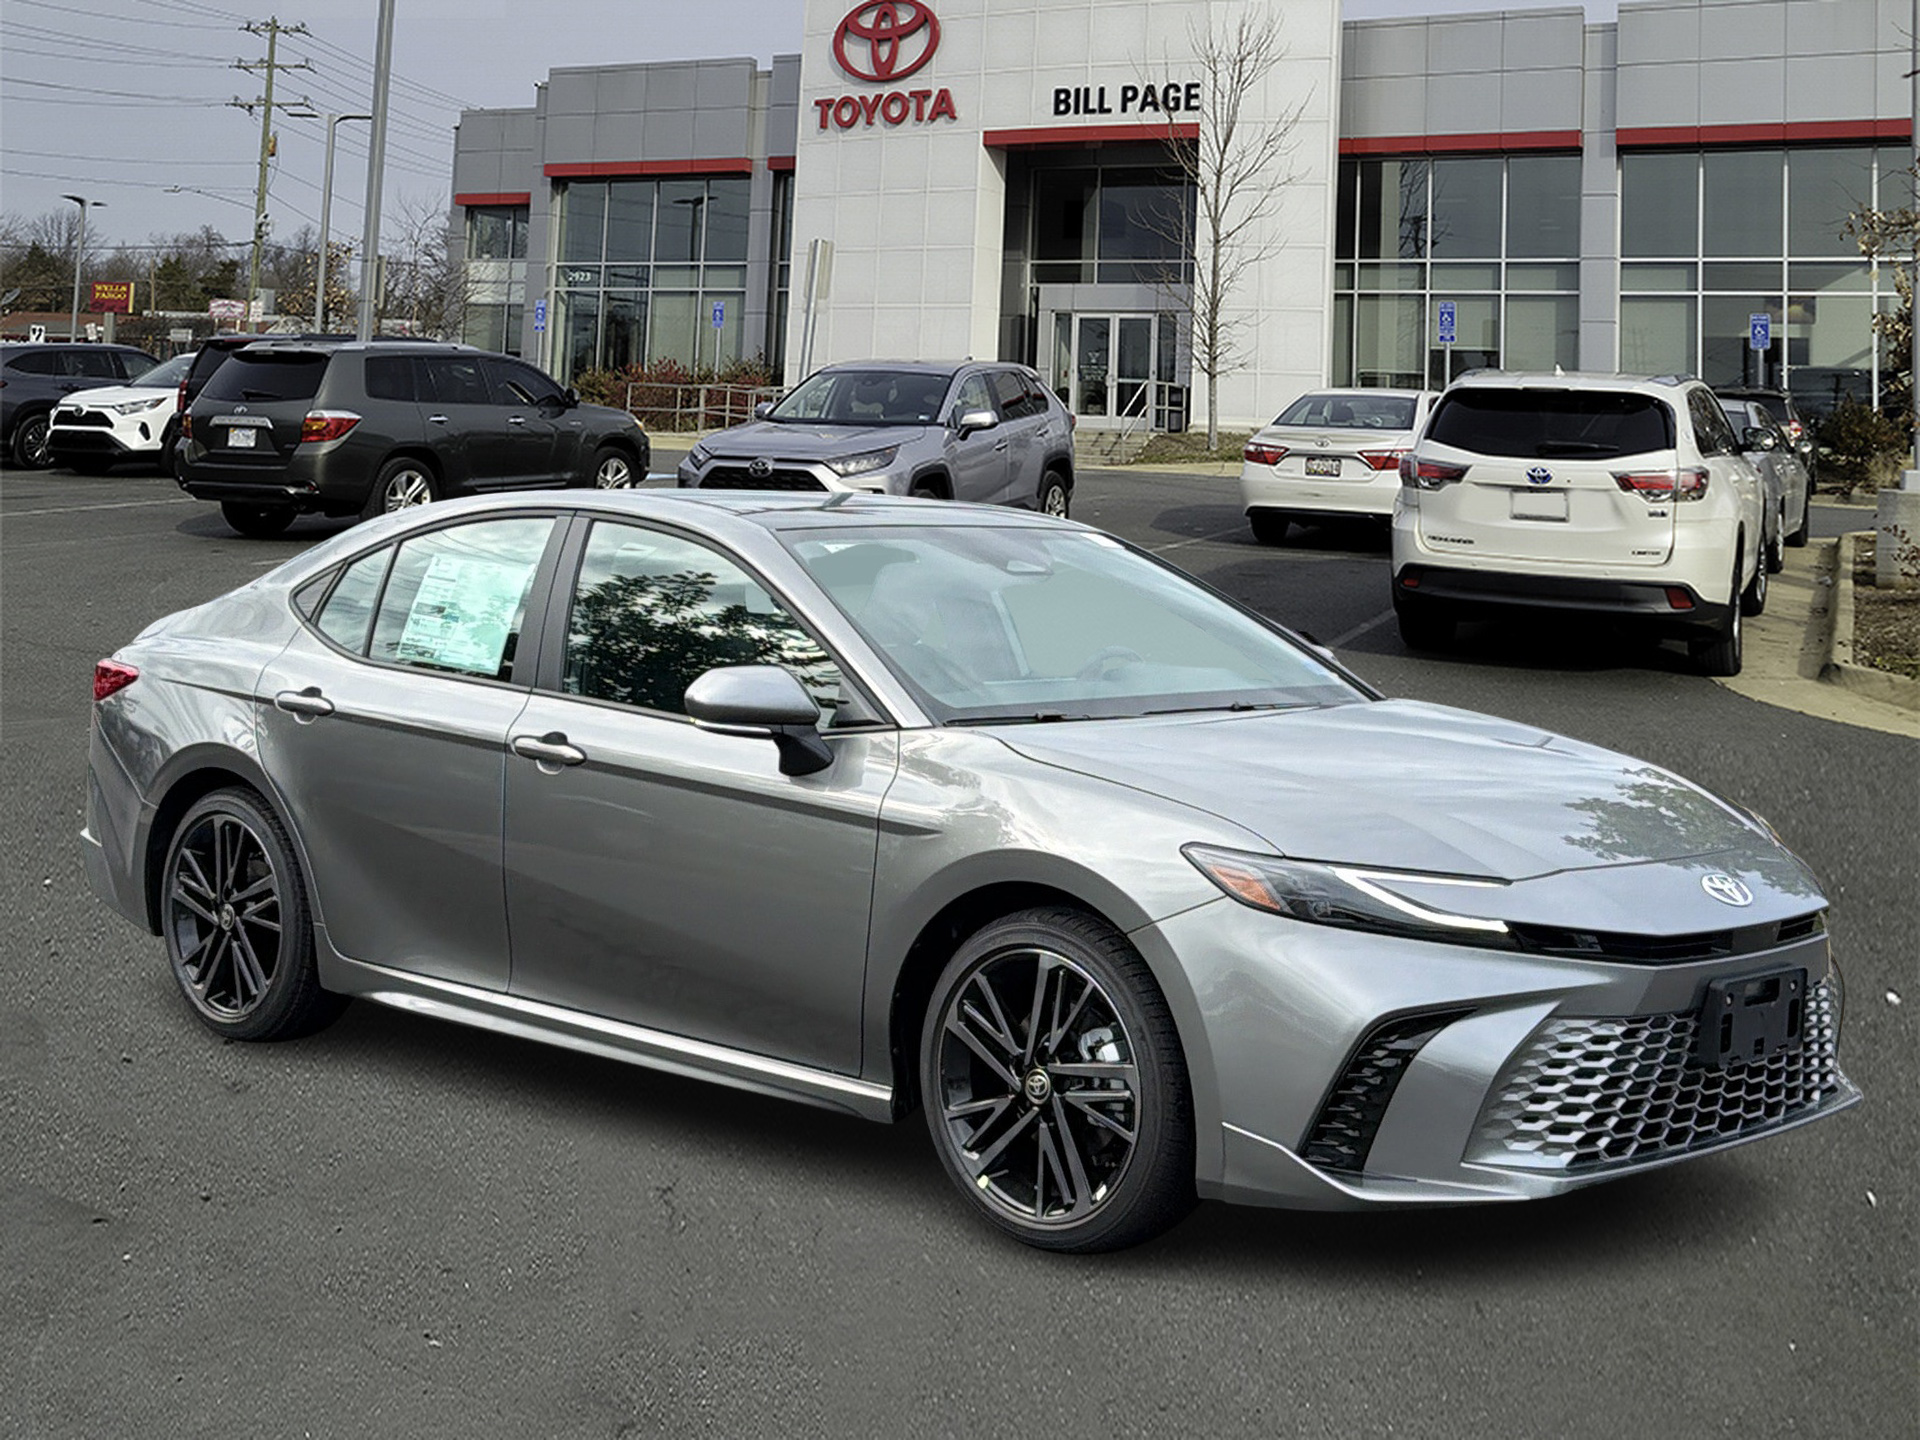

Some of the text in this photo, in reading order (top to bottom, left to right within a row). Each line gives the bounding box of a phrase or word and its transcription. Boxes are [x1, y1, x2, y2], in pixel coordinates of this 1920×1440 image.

[814, 88, 958, 129] TOYOTA
[1053, 82, 1201, 116] BILL PAGE
[95, 291, 127, 300] FARGO
